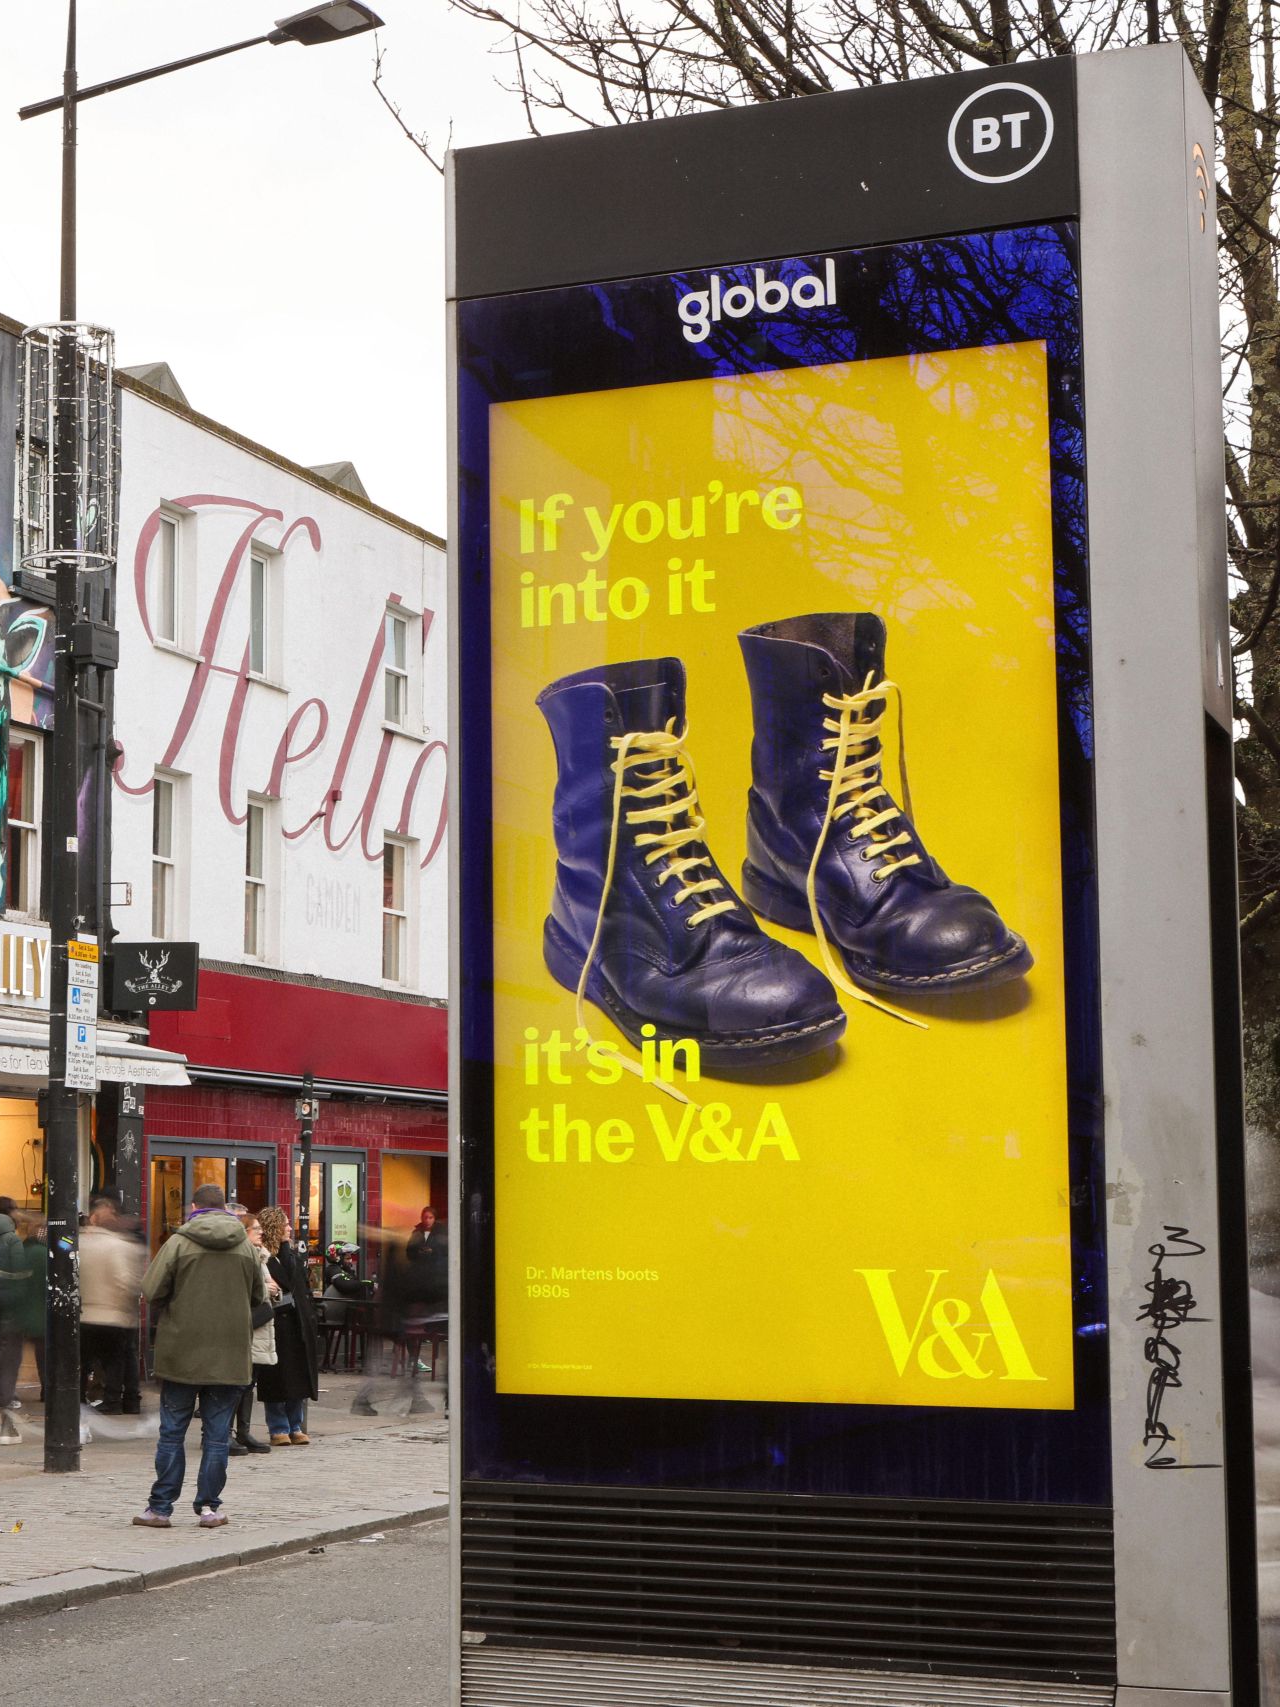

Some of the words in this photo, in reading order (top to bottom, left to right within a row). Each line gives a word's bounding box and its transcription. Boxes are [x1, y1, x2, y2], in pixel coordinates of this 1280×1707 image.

[971, 111, 1030, 154] BT
[677, 257, 837, 344] global
[519, 494, 574, 554] If
[581, 480, 803, 564] you're
[519, 572, 651, 629] into
[666, 558, 716, 616] it
[305, 872, 362, 935] CAMDEN
[9, 1053, 22, 1070] for
[25, 1054, 43, 1071] Tea
[95, 1064, 125, 1078] everage
[523, 1026, 625, 1087] it's
[640, 1023, 702, 1084] in
[519, 1104, 636, 1164] the
[644, 1101, 801, 1163] V&A
[526, 1266, 548, 1281] Dr.
[550, 1266, 614, 1281] Martens
[615, 1266, 660, 1281] boots
[526, 1283, 570, 1299] 1980s
[852, 1267, 1049, 1382] V&A
